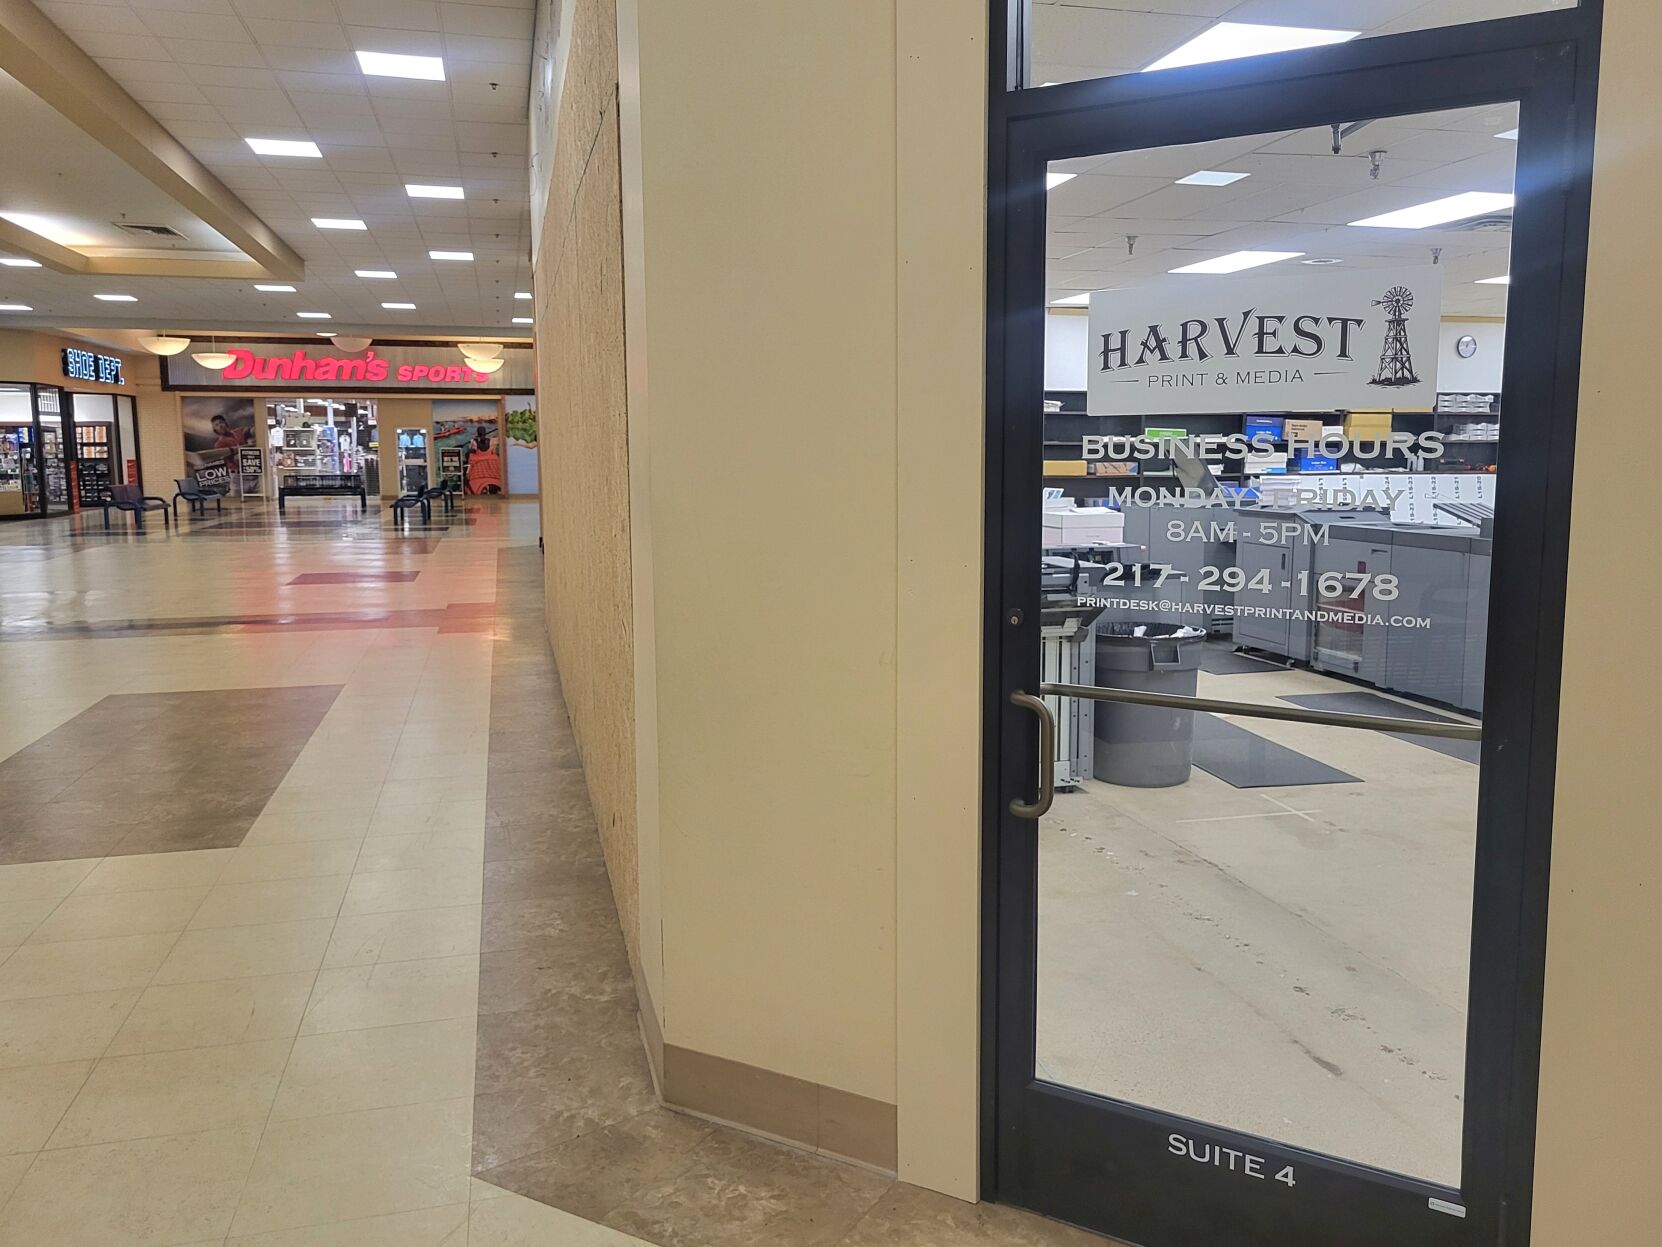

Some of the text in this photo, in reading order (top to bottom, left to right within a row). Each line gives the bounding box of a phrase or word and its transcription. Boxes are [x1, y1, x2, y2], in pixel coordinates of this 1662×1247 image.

[1099, 307, 1367, 373] HARVEST
[67, 348, 96, 380] SHOE
[222, 349, 389, 381] Dunham's
[1148, 369, 1305, 388] PRINT & MEDIA
[1081, 431, 1446, 460] BUSINESS HOURS
[196, 466, 227, 481] LOW
[199, 476, 231, 487] PRICES
[1108, 486, 1249, 509] MONDAY
[1272, 488, 1407, 511] FRIDAY
[1166, 520, 1236, 544] 8AM
[1258, 522, 1331, 546] 5PM
[1076, 596, 1432, 629] PRINTDESK@HARVESTPRINTANDMEDIA.COM
[1167, 1133, 1296, 1187] SUITE 4
